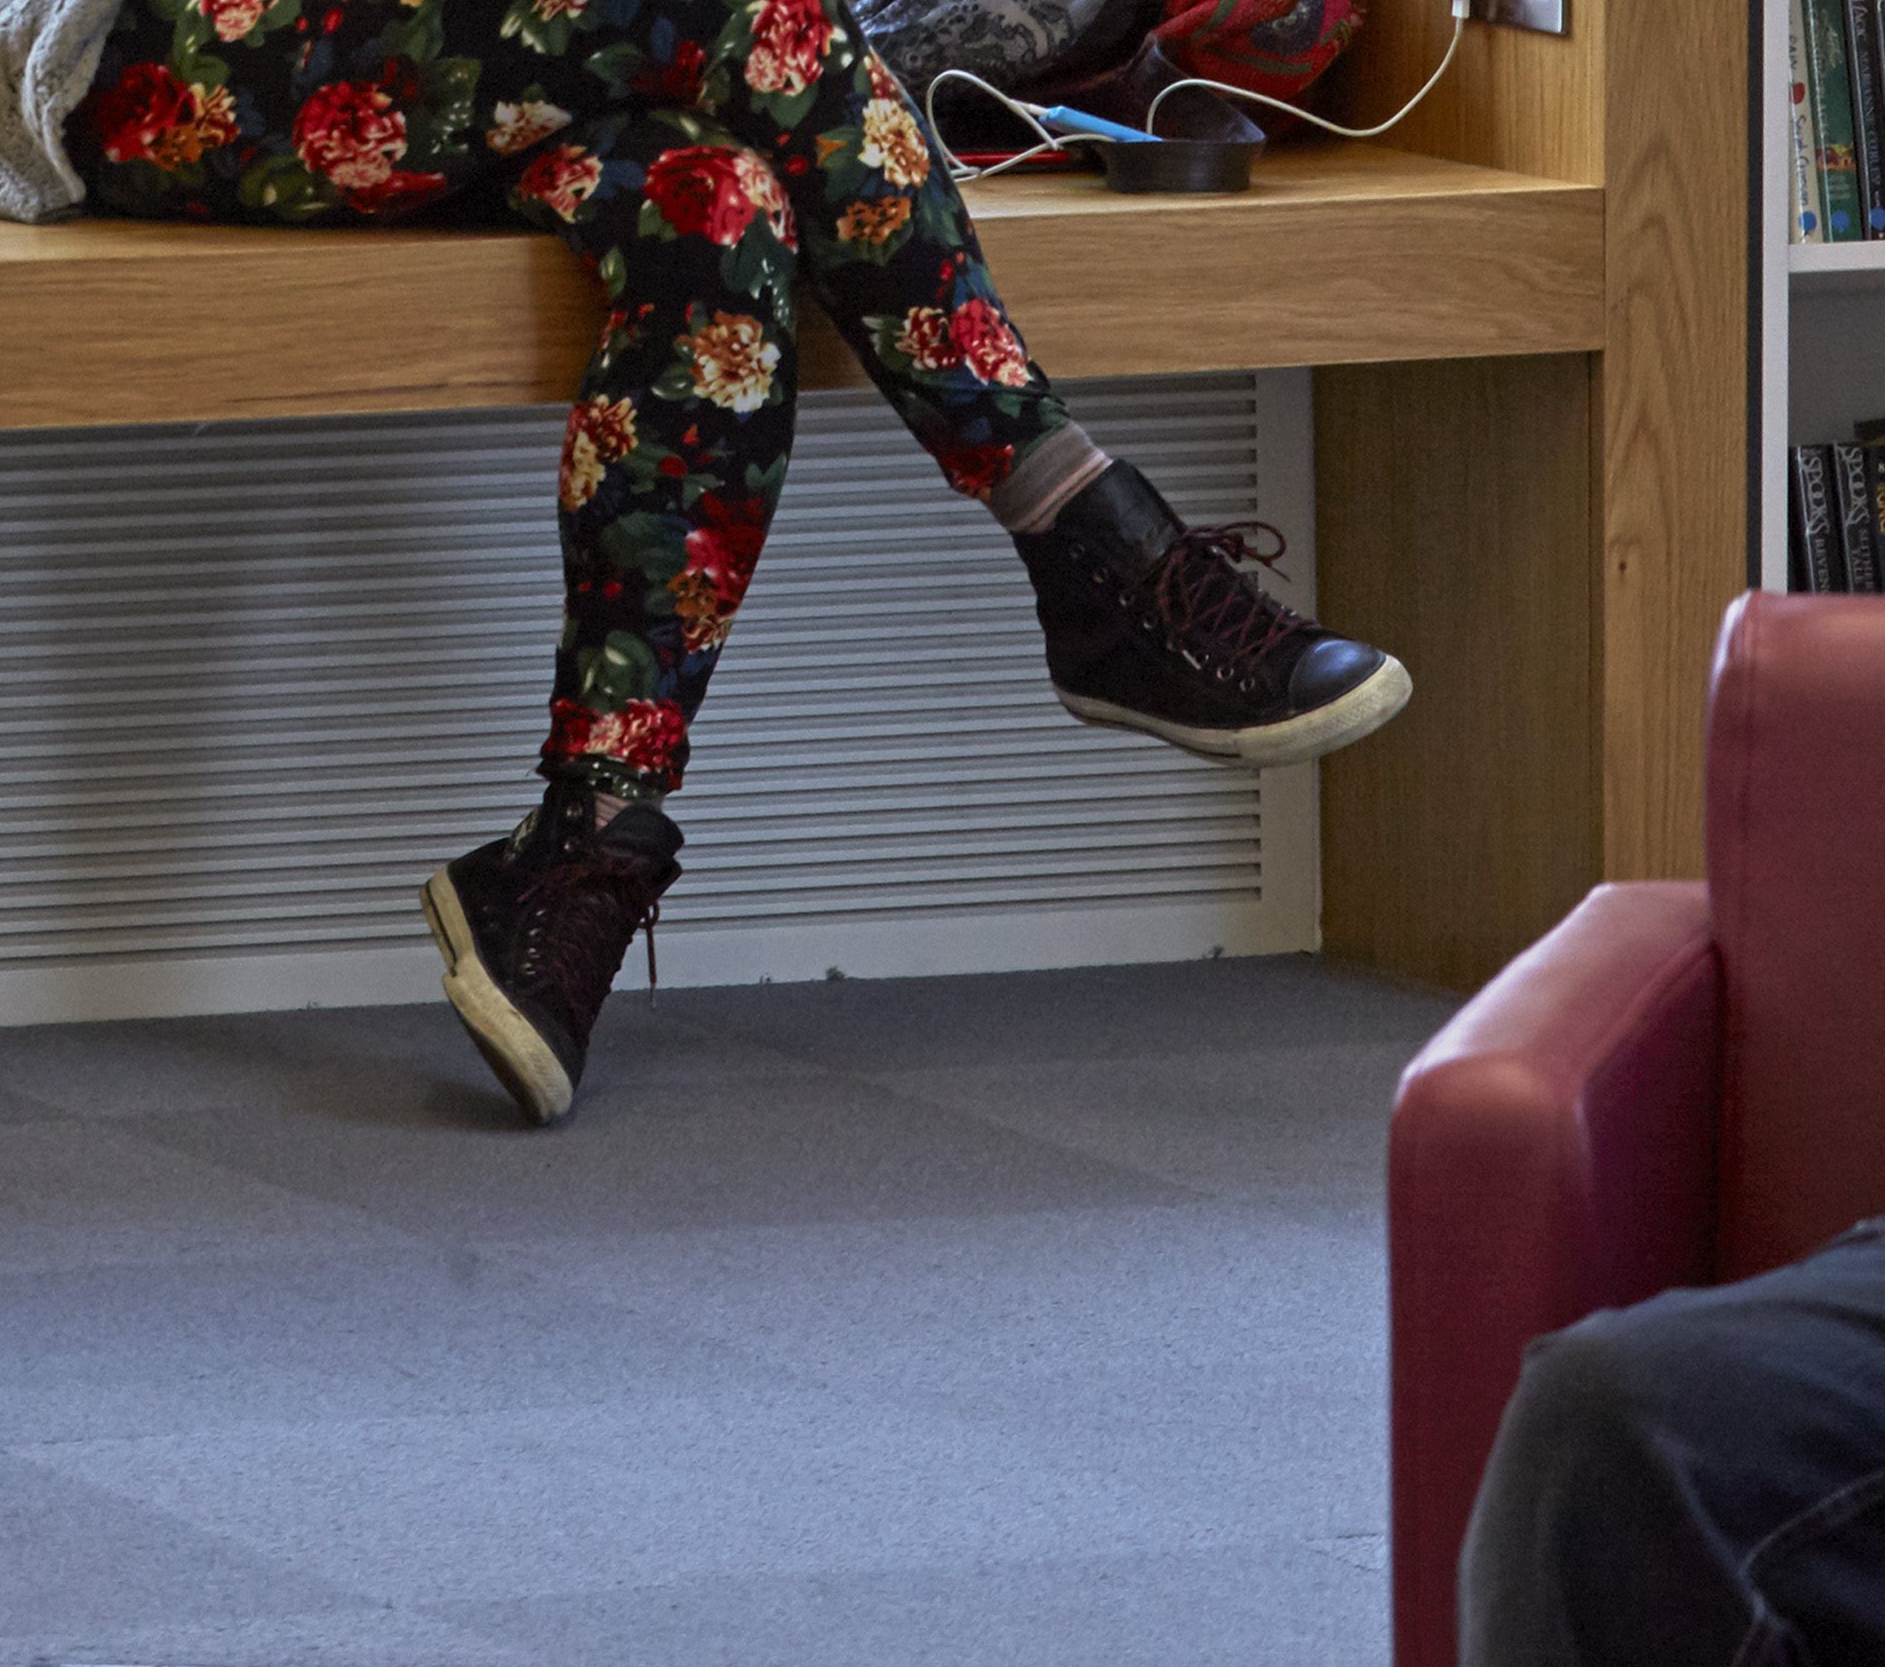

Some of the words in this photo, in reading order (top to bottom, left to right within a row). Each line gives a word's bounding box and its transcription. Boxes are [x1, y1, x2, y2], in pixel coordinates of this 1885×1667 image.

[1860, 49, 1876, 125] MARIANNE
[1867, 130, 1881, 185] CURLEY
[1814, 538, 1830, 594] REVEN
